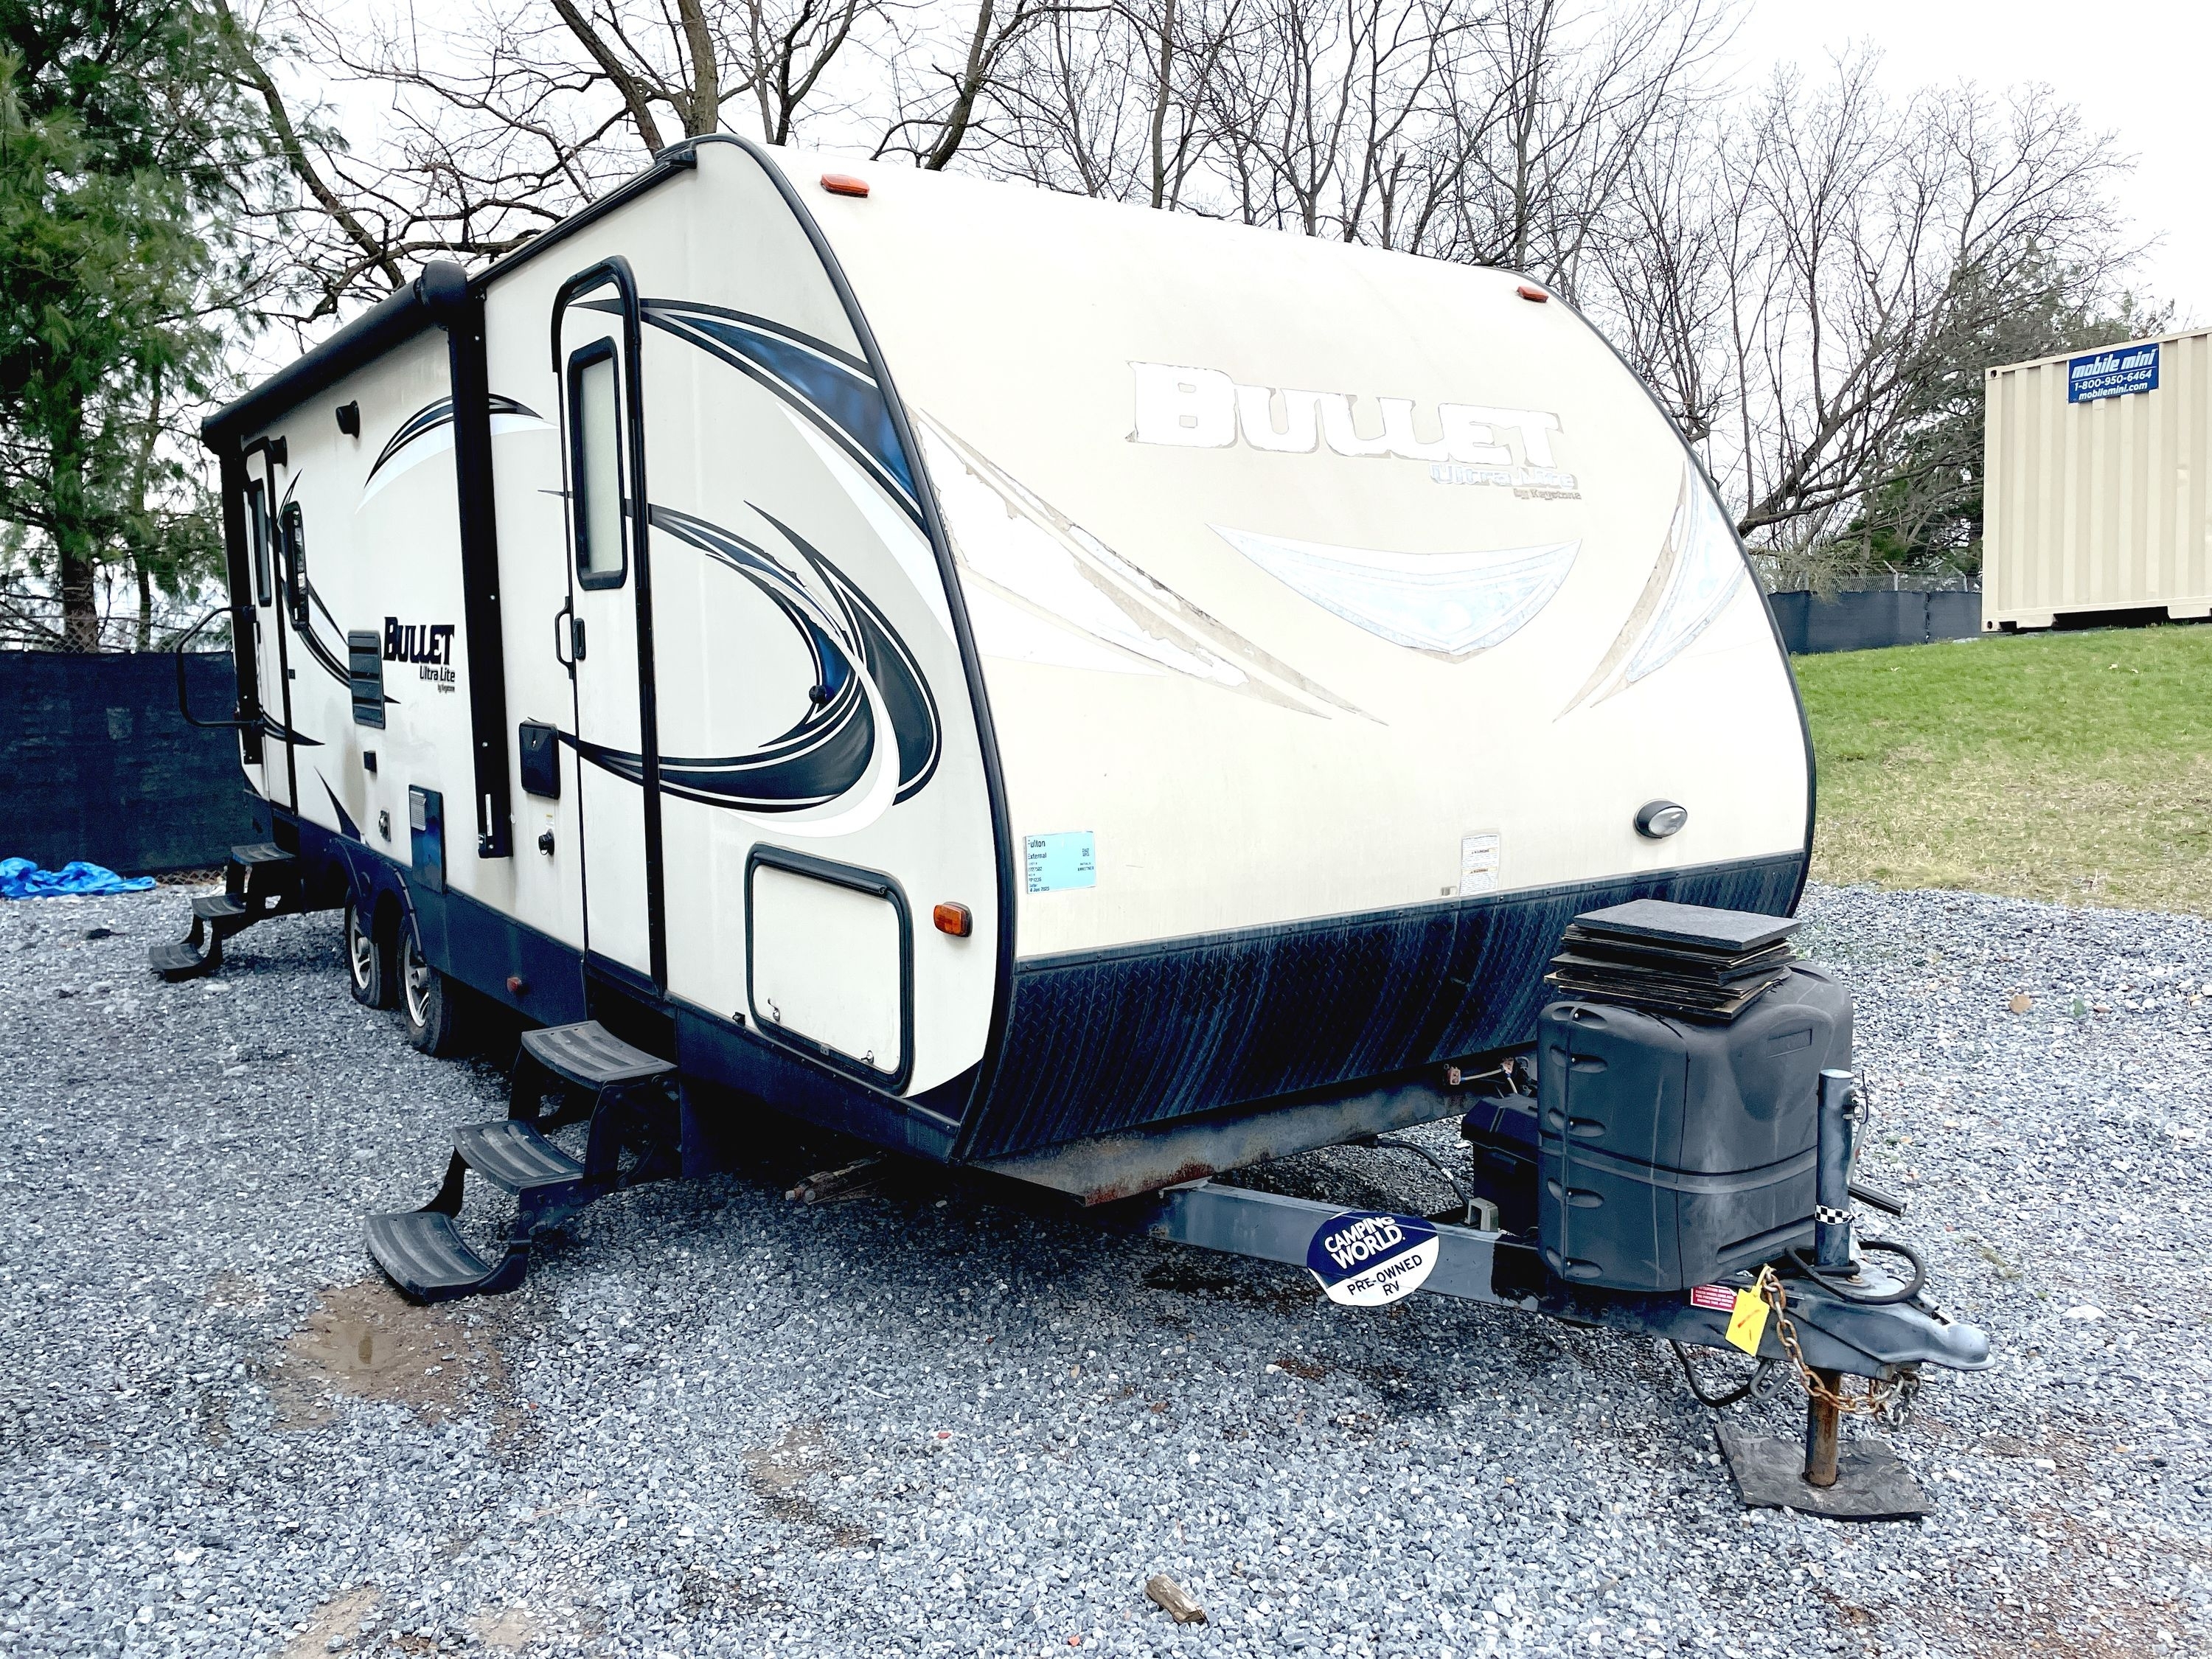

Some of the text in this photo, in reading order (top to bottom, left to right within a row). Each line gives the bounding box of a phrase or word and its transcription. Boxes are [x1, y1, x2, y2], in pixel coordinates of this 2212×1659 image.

[2071, 348, 2156, 379] mobile mini
[2075, 369, 2152, 391] 1-800-950-6464
[2078, 382, 2148, 400] mobilemini.com
[1125, 361, 1564, 468] BULLET
[382, 616, 455, 665] BULLET
[420, 665, 455, 682] Ultra Lite
[1324, 1217, 1395, 1253] CAMPING
[1347, 1254, 1422, 1295] PRE-OWNED
[1382, 1281, 1399, 1295] RV
